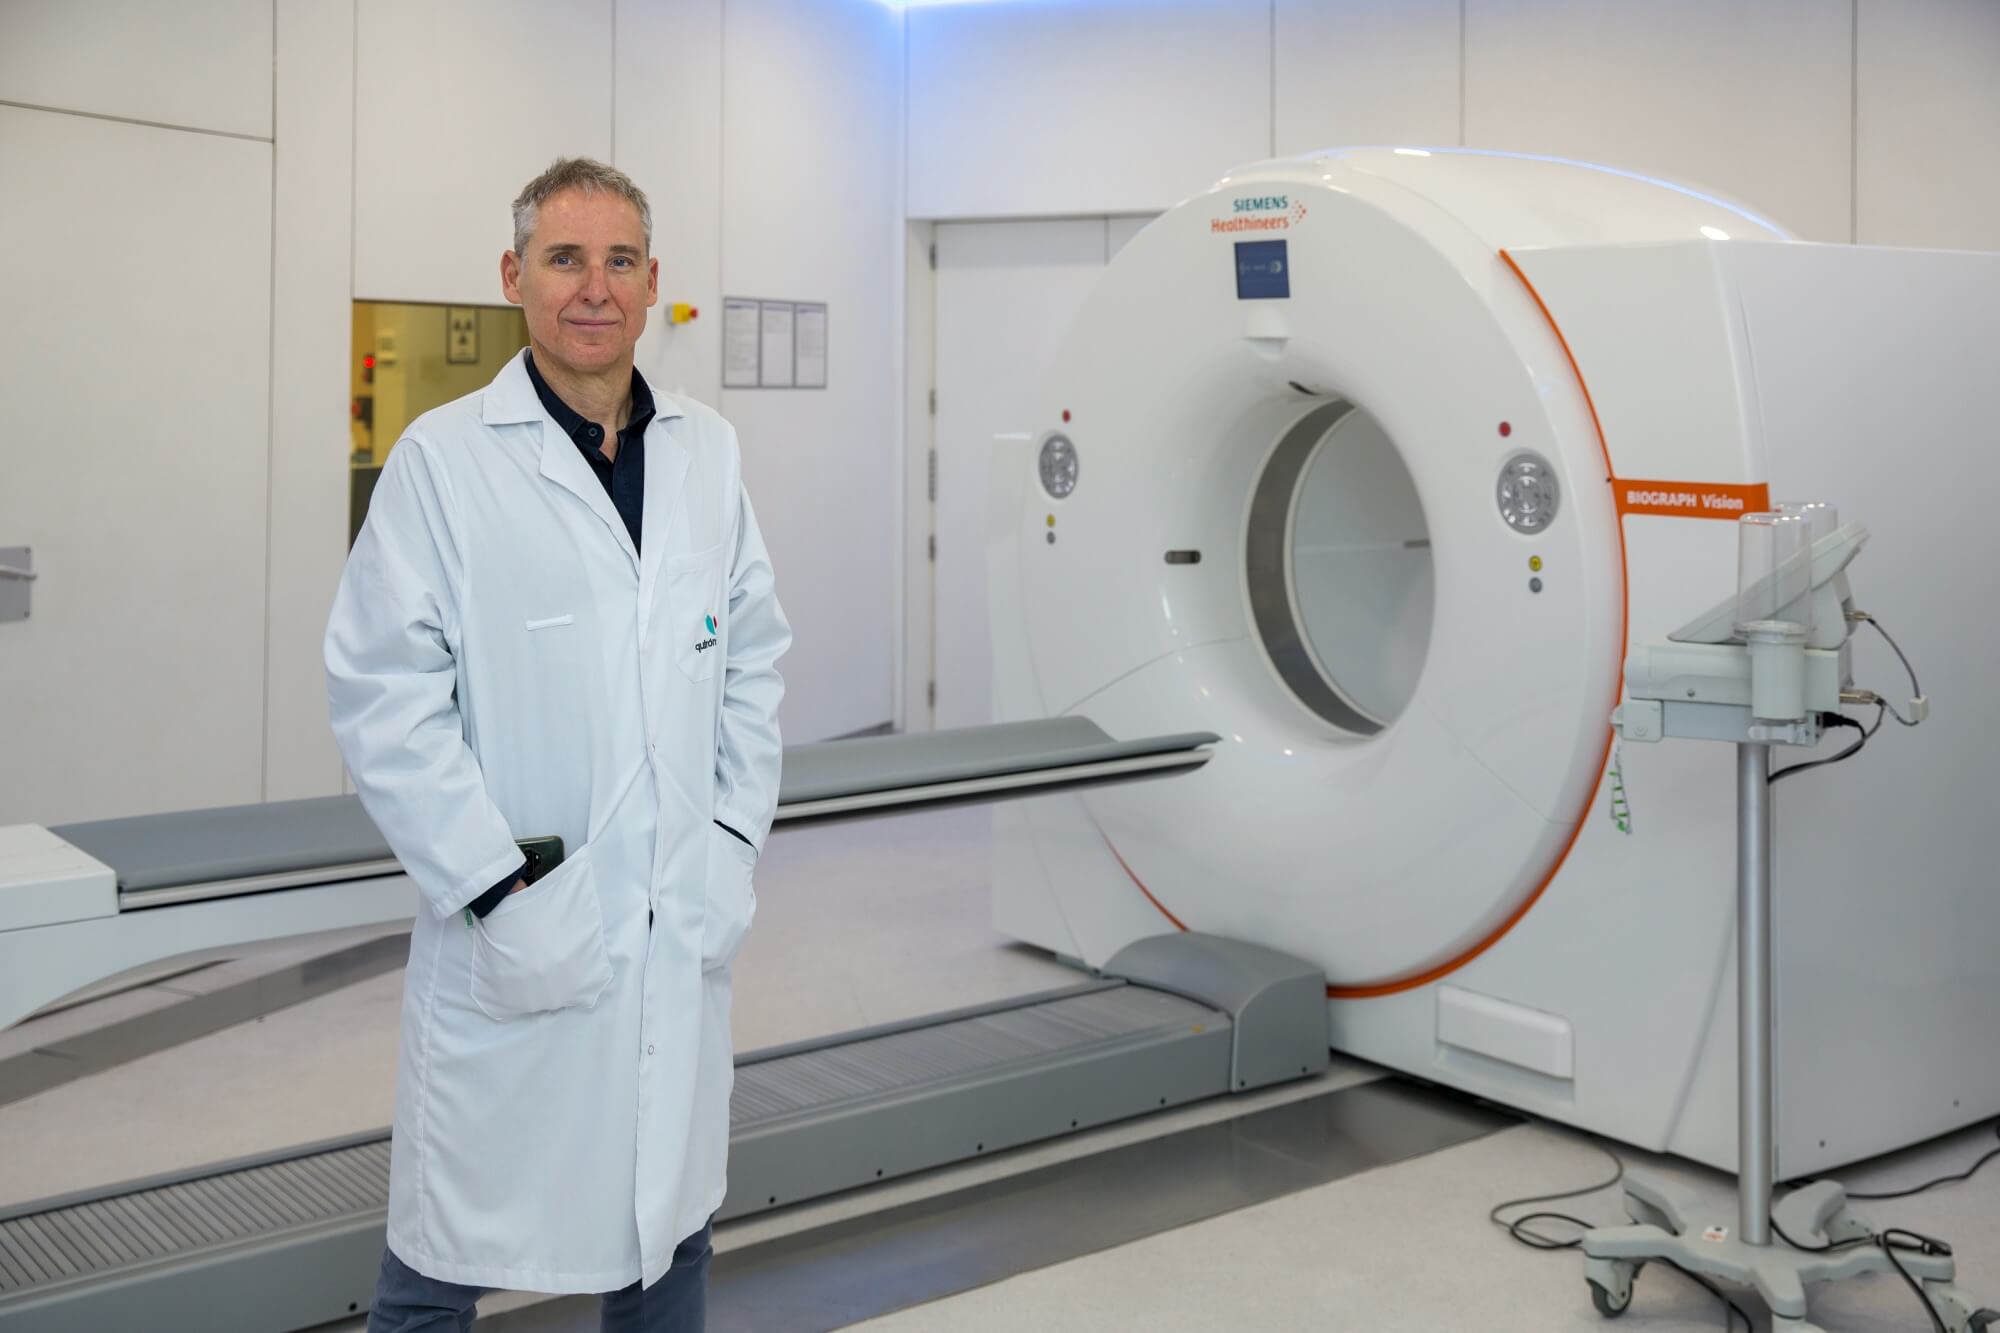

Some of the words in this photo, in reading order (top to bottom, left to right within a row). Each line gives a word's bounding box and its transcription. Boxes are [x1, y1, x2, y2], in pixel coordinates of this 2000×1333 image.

[1233, 196, 1288, 212] SIEMENS
[1211, 215, 1289, 232] Healthineers
[1627, 490, 1697, 507] BIOGRAPH
[1701, 494, 1744, 510] Vision
